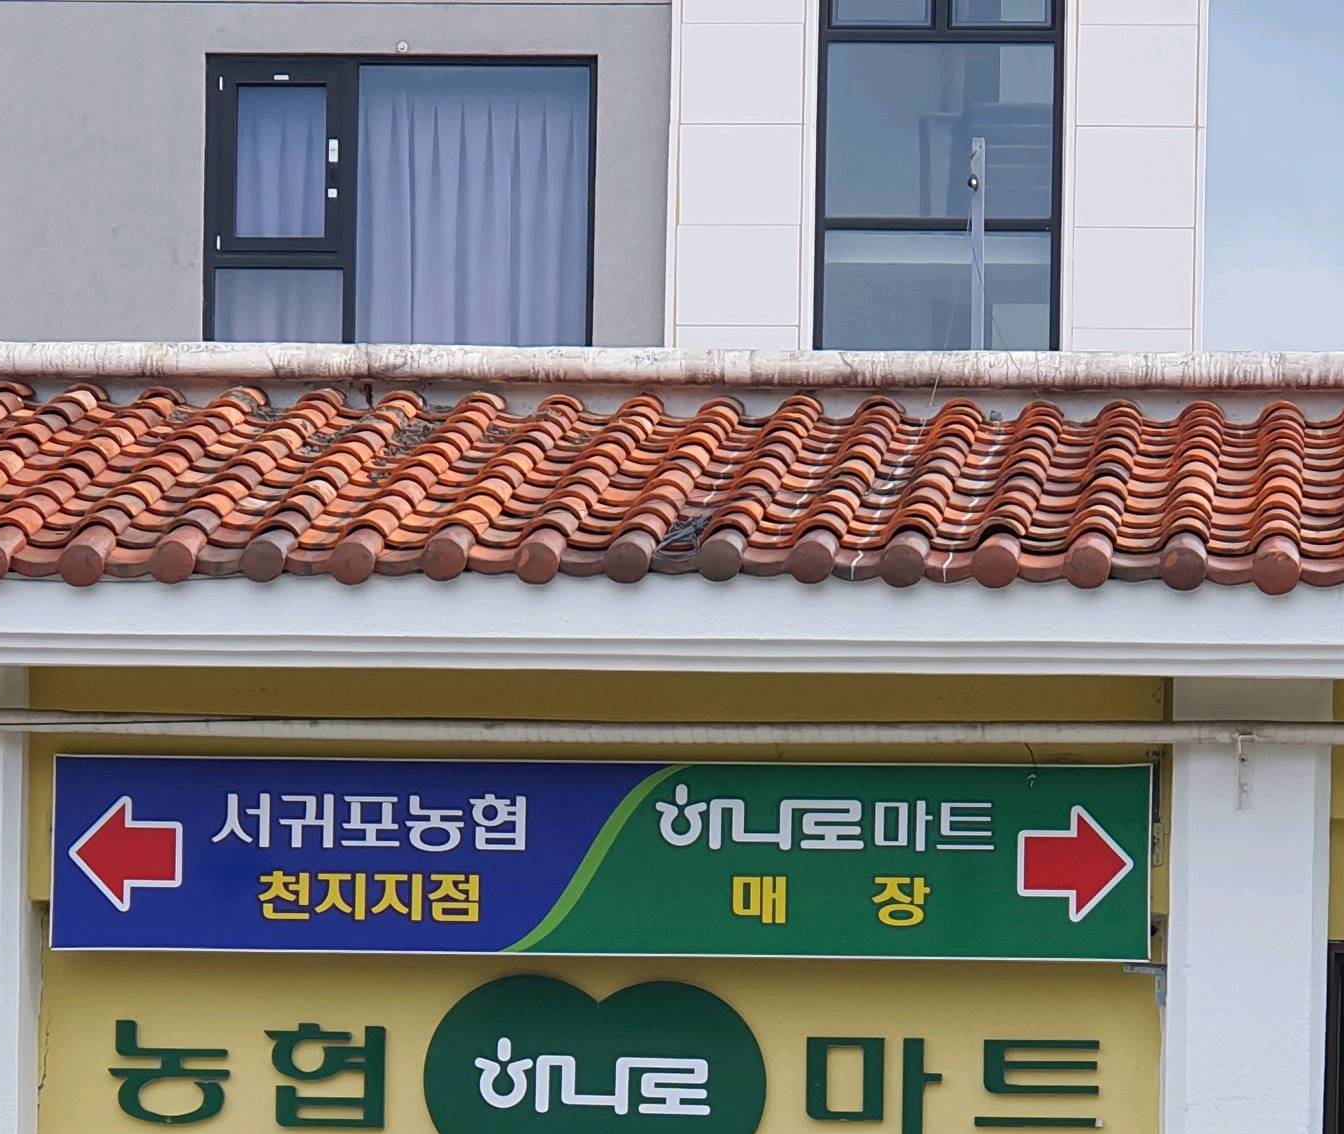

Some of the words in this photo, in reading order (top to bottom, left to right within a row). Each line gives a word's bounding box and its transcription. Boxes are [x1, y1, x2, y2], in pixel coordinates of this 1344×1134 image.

[210, 792, 528, 854] 서귀포농협
[654, 782, 996, 853] 하나로마트
[257, 869, 481, 923] 천지지점
[472, 1036, 712, 1117] 하나로
